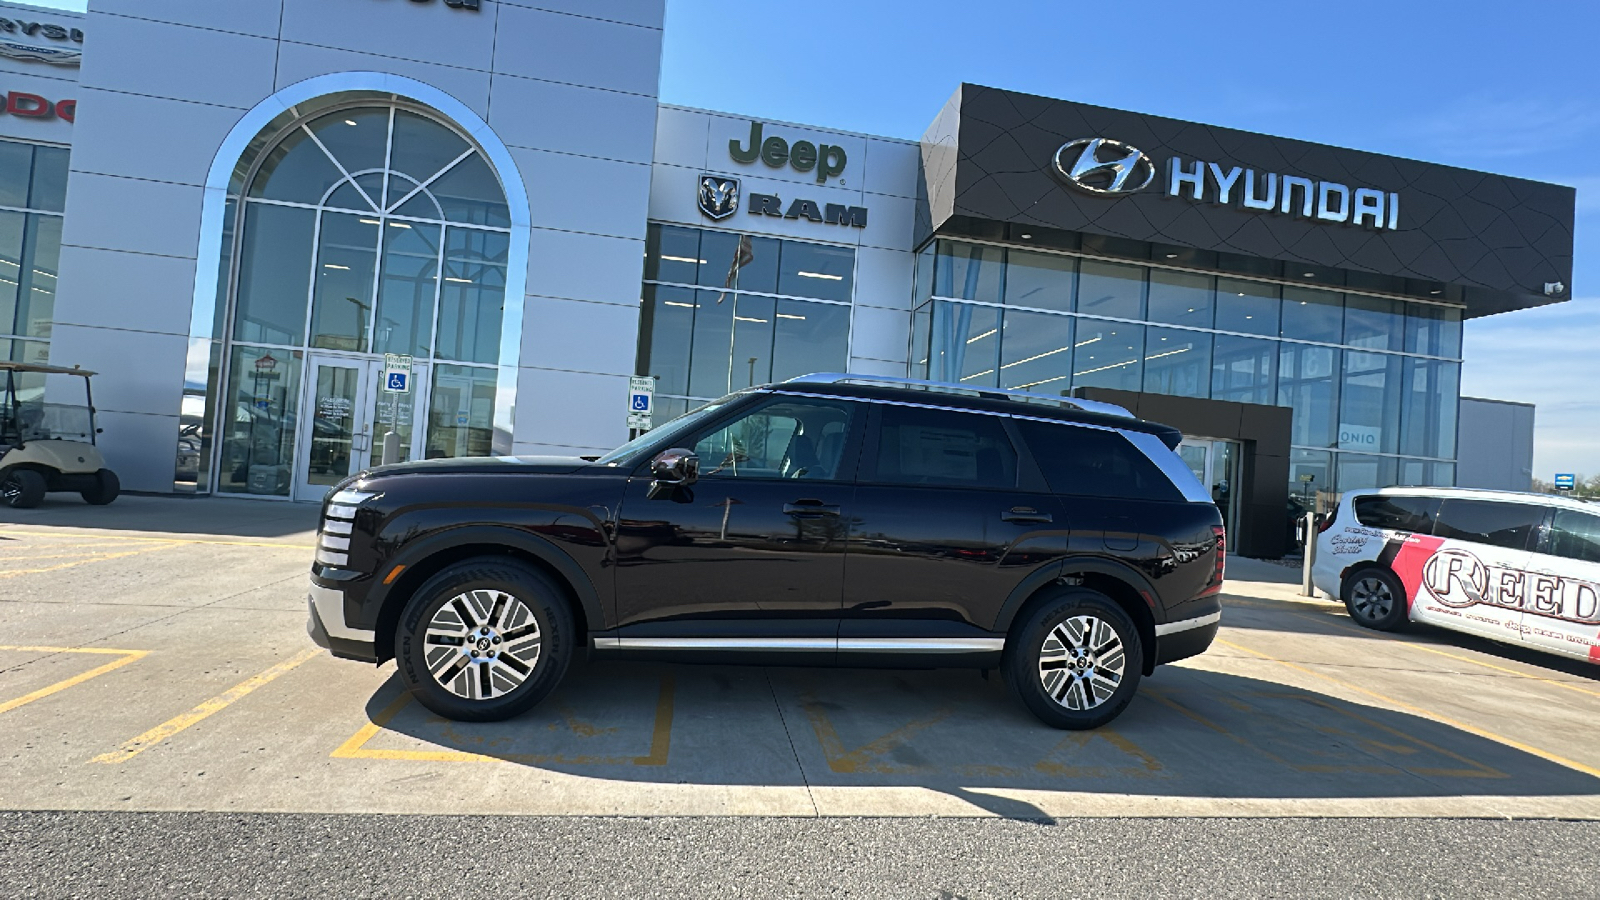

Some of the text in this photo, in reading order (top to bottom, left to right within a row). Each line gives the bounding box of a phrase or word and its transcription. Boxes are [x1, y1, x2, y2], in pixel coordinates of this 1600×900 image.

[729, 121, 847, 184] Jeep
[748, 193, 868, 228] RAM
[1166, 157, 1399, 231] HYUNDAI
[1341, 431, 1374, 444] ONIQ
[1423, 549, 1598, 622] REED
[544, 606, 560, 653] NEXEN
[403, 636, 419, 684] NEXEN
